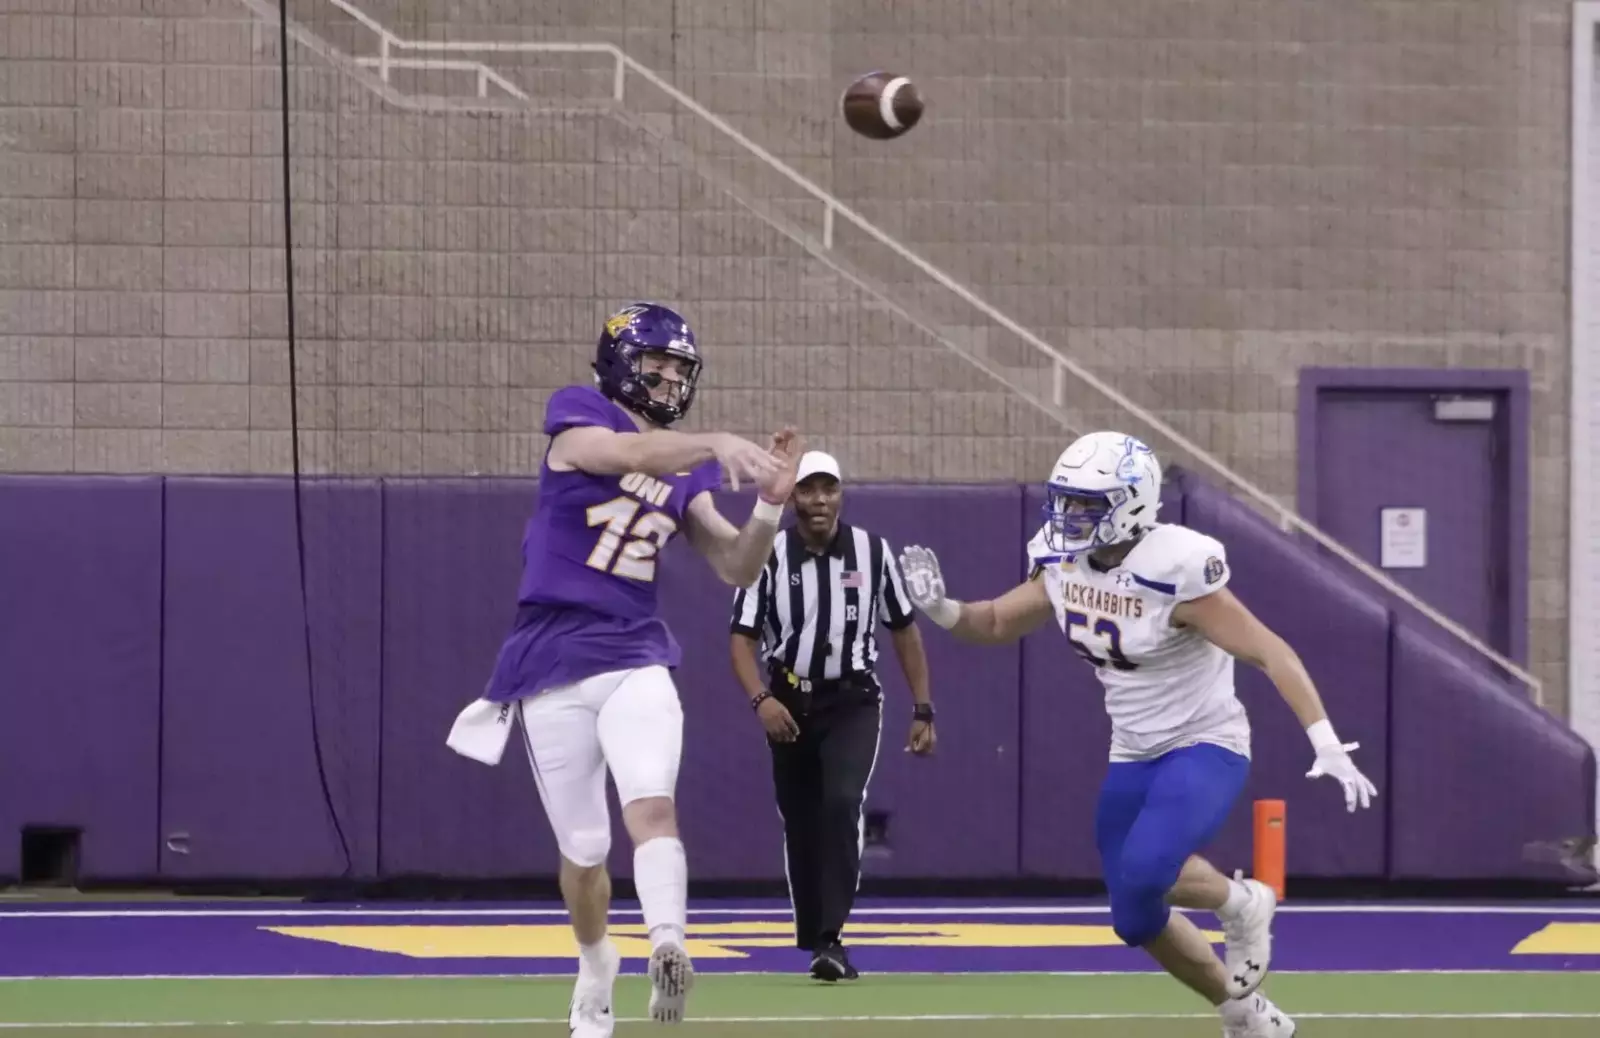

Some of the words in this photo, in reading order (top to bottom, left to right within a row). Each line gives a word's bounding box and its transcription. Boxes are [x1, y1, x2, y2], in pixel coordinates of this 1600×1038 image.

[619, 472, 674, 507] UNI
[586, 496, 677, 582] 12
[790, 572, 801, 586] S
[846, 604, 858, 621] R
